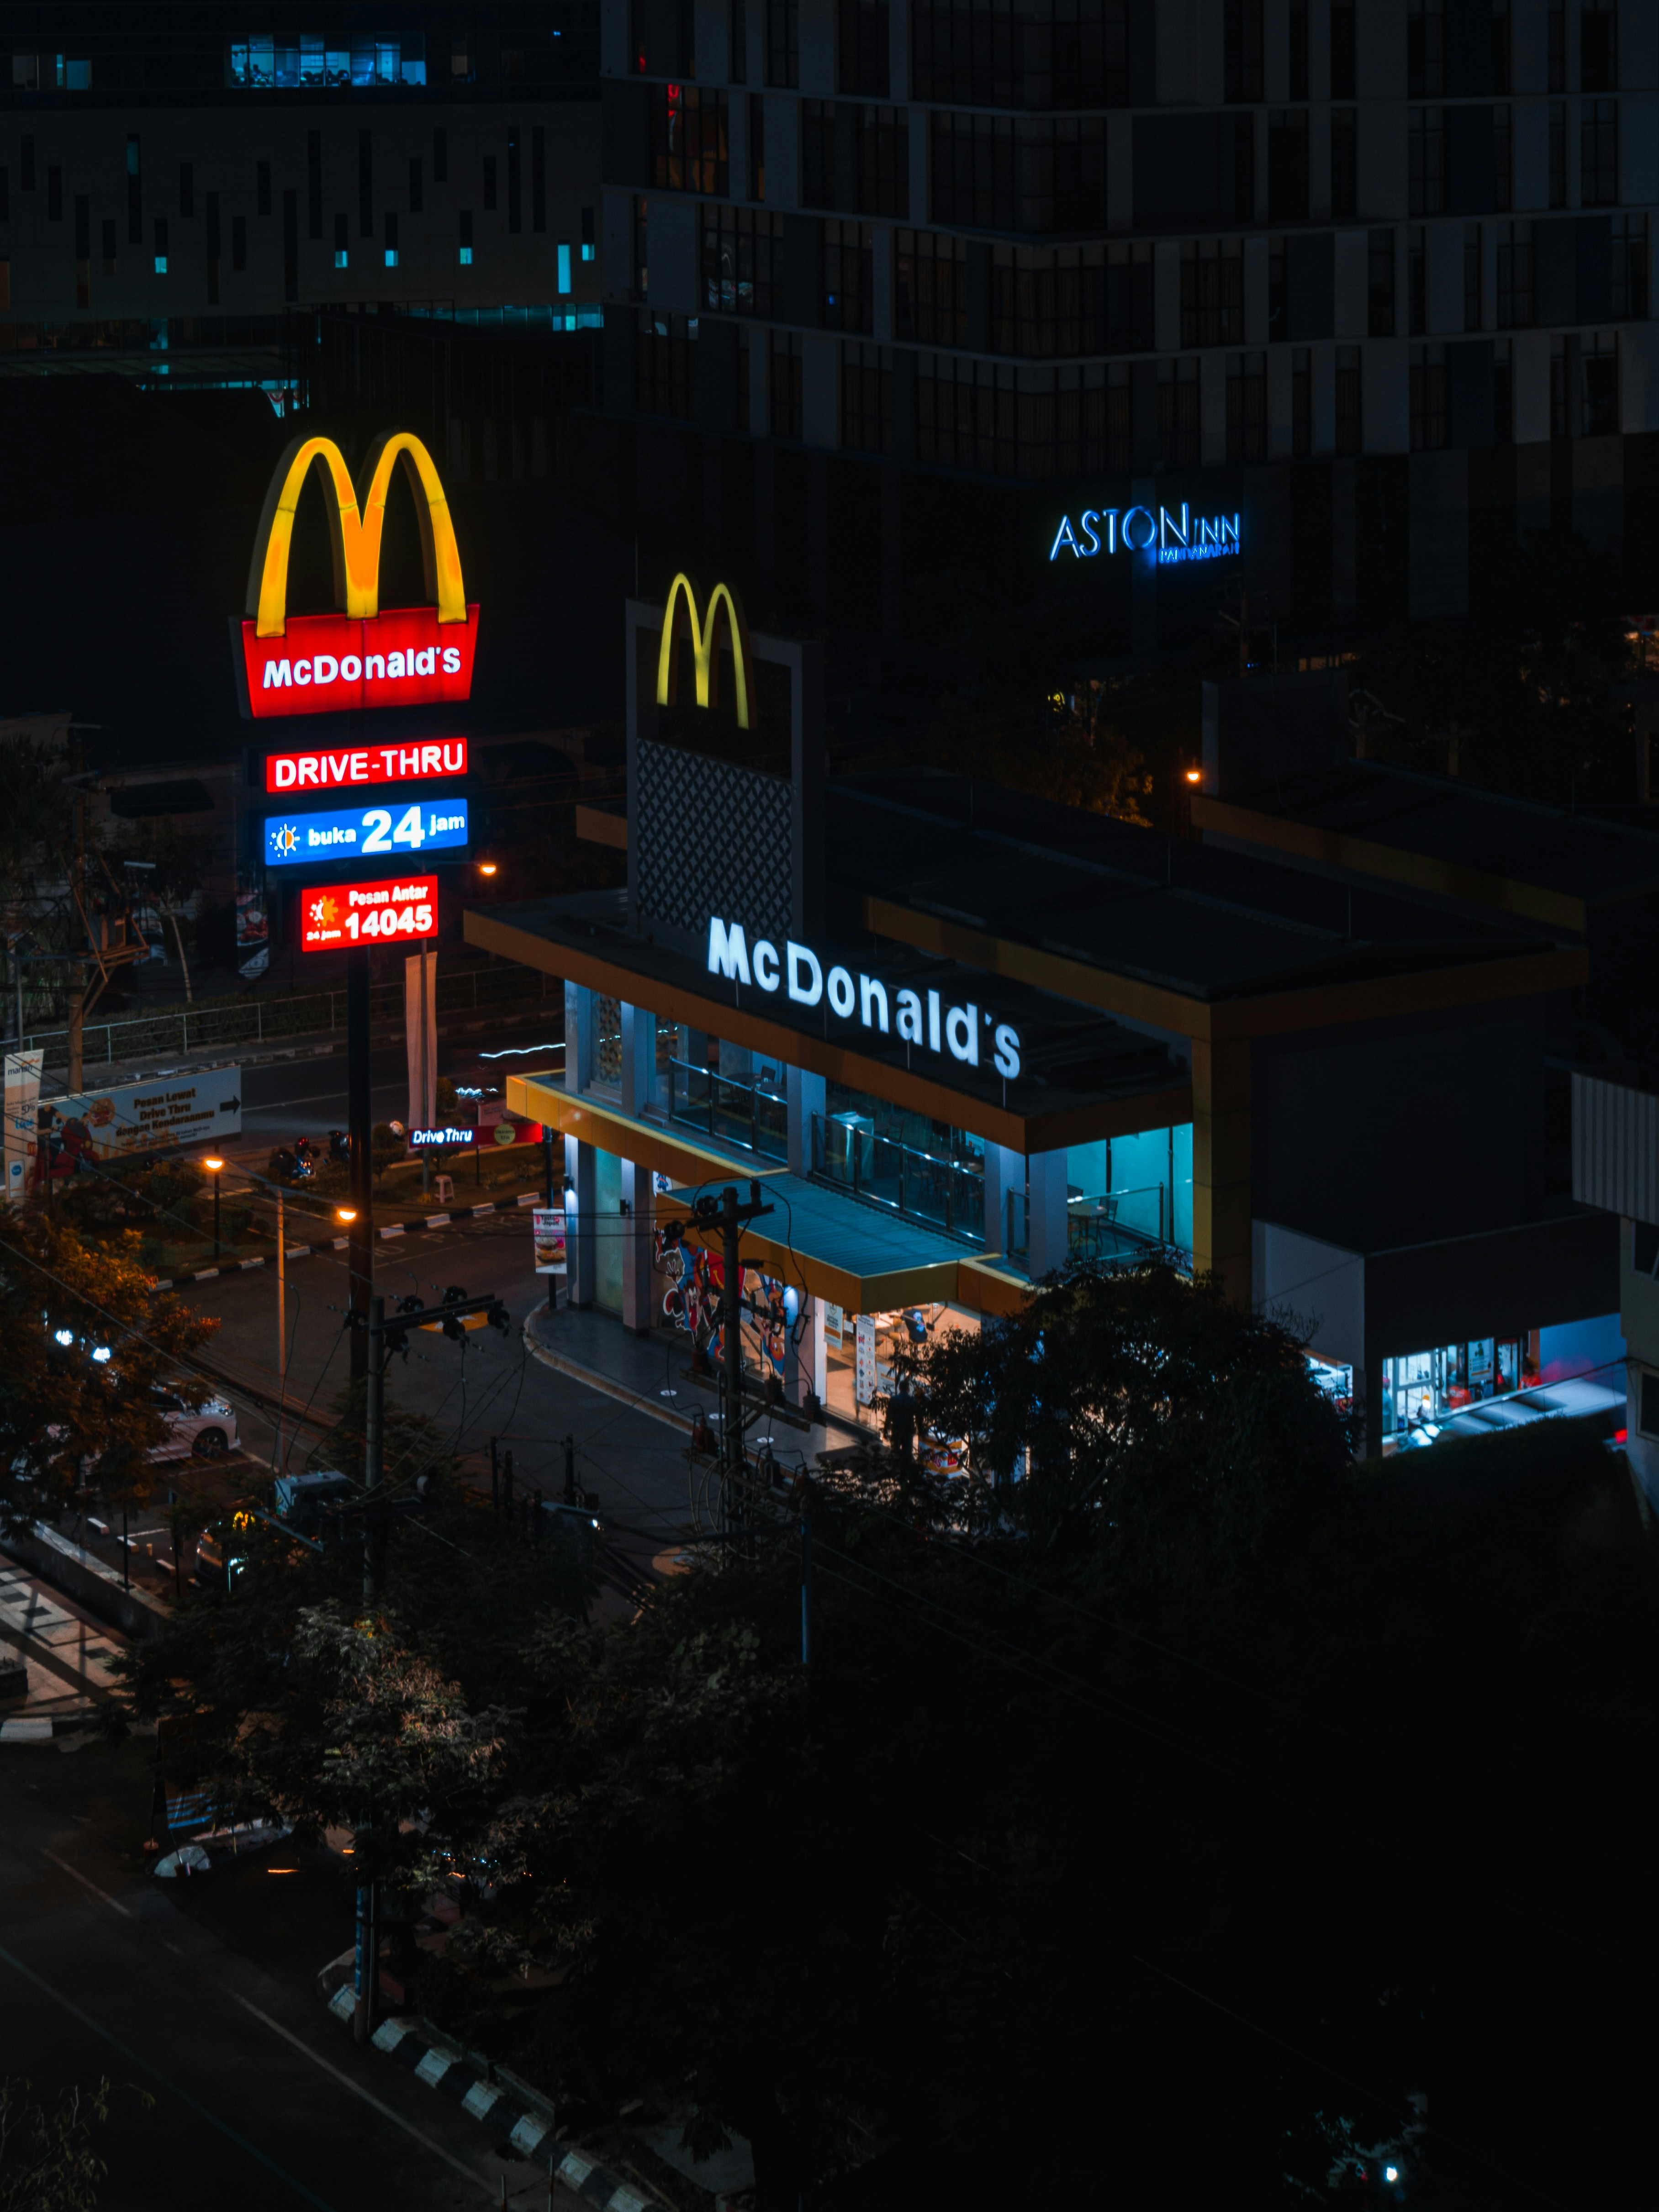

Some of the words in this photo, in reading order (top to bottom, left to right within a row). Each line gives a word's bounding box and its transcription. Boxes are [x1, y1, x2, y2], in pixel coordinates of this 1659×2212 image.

[1050, 502, 1189, 561] ASTON
[1194, 512, 1240, 544] INN
[263, 645, 461, 689] McDonald's
[308, 827, 356, 846] buka
[361, 806, 425, 853] 24
[428, 813, 465, 836] jam
[349, 890, 389, 906] Pesan
[392, 884, 428, 903] Antar
[345, 904, 433, 940] 14045
[708, 916, 1020, 1080] McDonald's
[133, 1095, 164, 1109] Pesan
[166, 1088, 196, 1102] Lewat
[140, 1108, 166, 1120] Drive
[168, 1103, 191, 1114] Thru
[116, 1123, 150, 1136] dengan
[152, 1110, 215, 1129] Kendaraanmu
[412, 1129, 444, 1144] Drive
[445, 1127, 473, 1143] Thru
